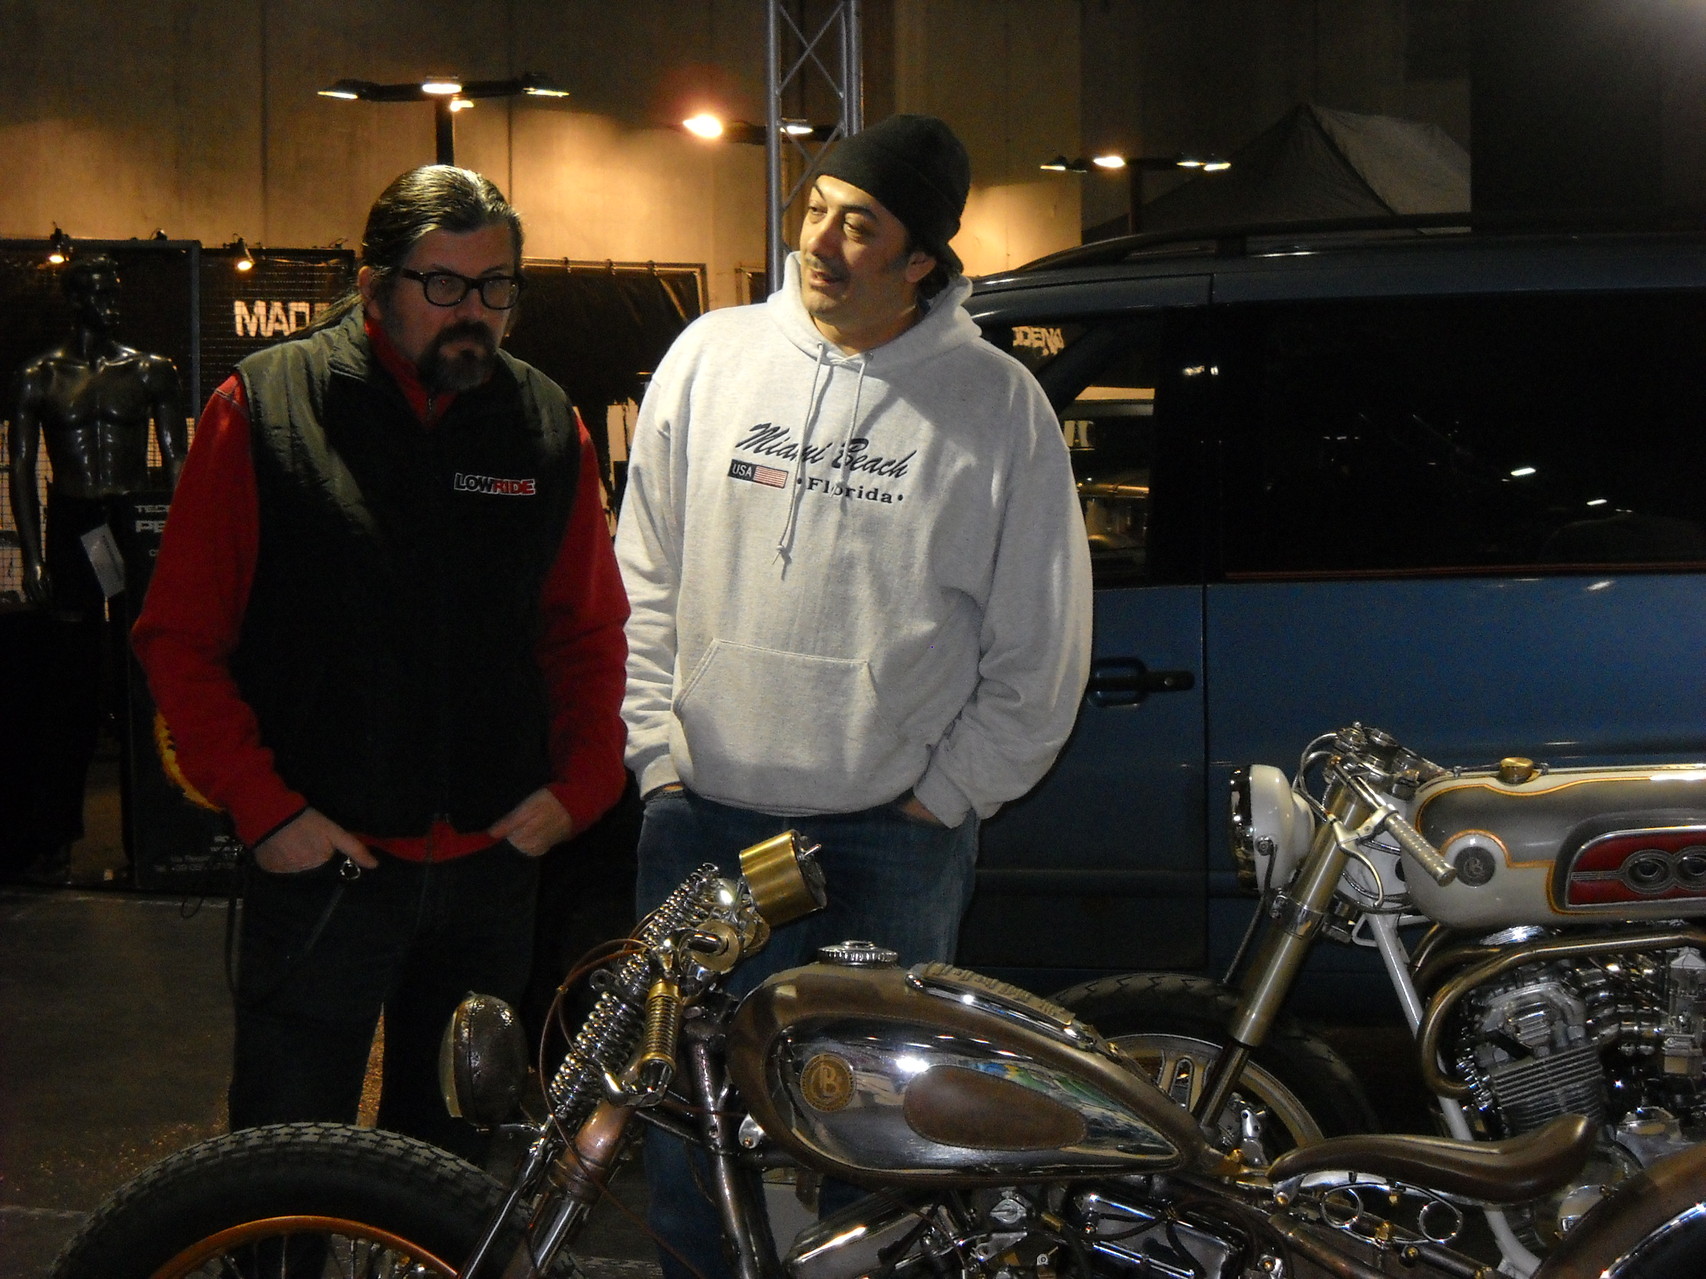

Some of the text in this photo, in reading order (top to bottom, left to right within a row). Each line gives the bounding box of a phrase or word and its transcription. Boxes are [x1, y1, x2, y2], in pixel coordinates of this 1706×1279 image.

[234, 300, 331, 337] MAD
[735, 422, 917, 479] Miami Beach
[453, 472, 536, 496] LOWRIDE
[731, 462, 753, 478] USA
